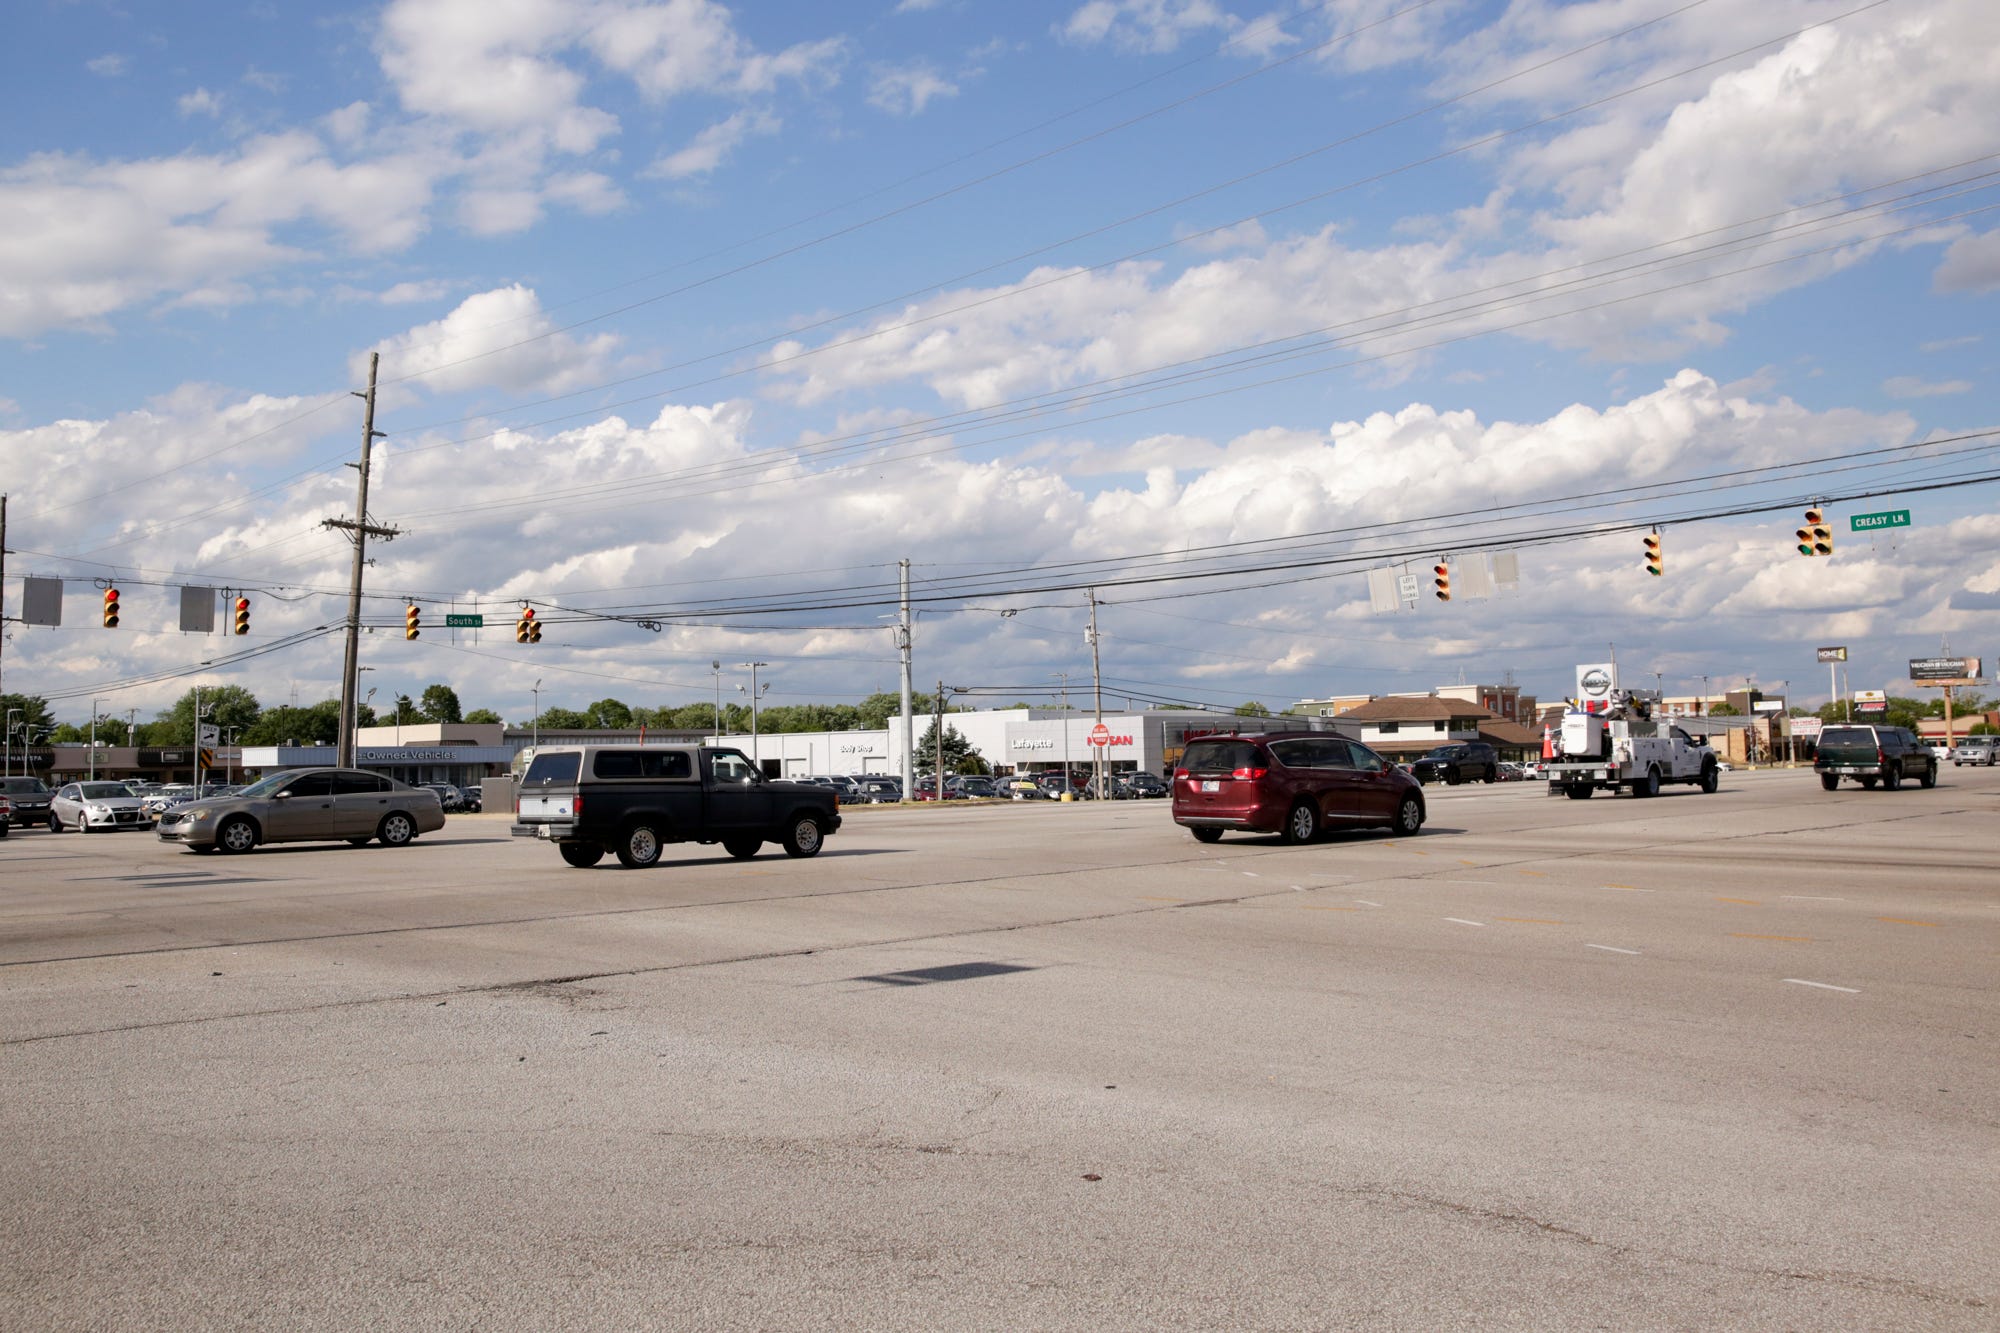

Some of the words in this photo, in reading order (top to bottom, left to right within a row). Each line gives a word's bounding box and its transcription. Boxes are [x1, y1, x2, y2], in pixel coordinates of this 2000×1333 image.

[1856, 515, 1887, 527] CREASY
[448, 616, 473, 625] South
[203, 725, 218, 733] KEEP
[200, 740, 217, 749] RIGHT
[1012, 738, 1053, 750] Lafayette
[840, 744, 855, 754] Body
[857, 744, 873, 753] Shop
[411, 751, 457, 760] Vehicles
